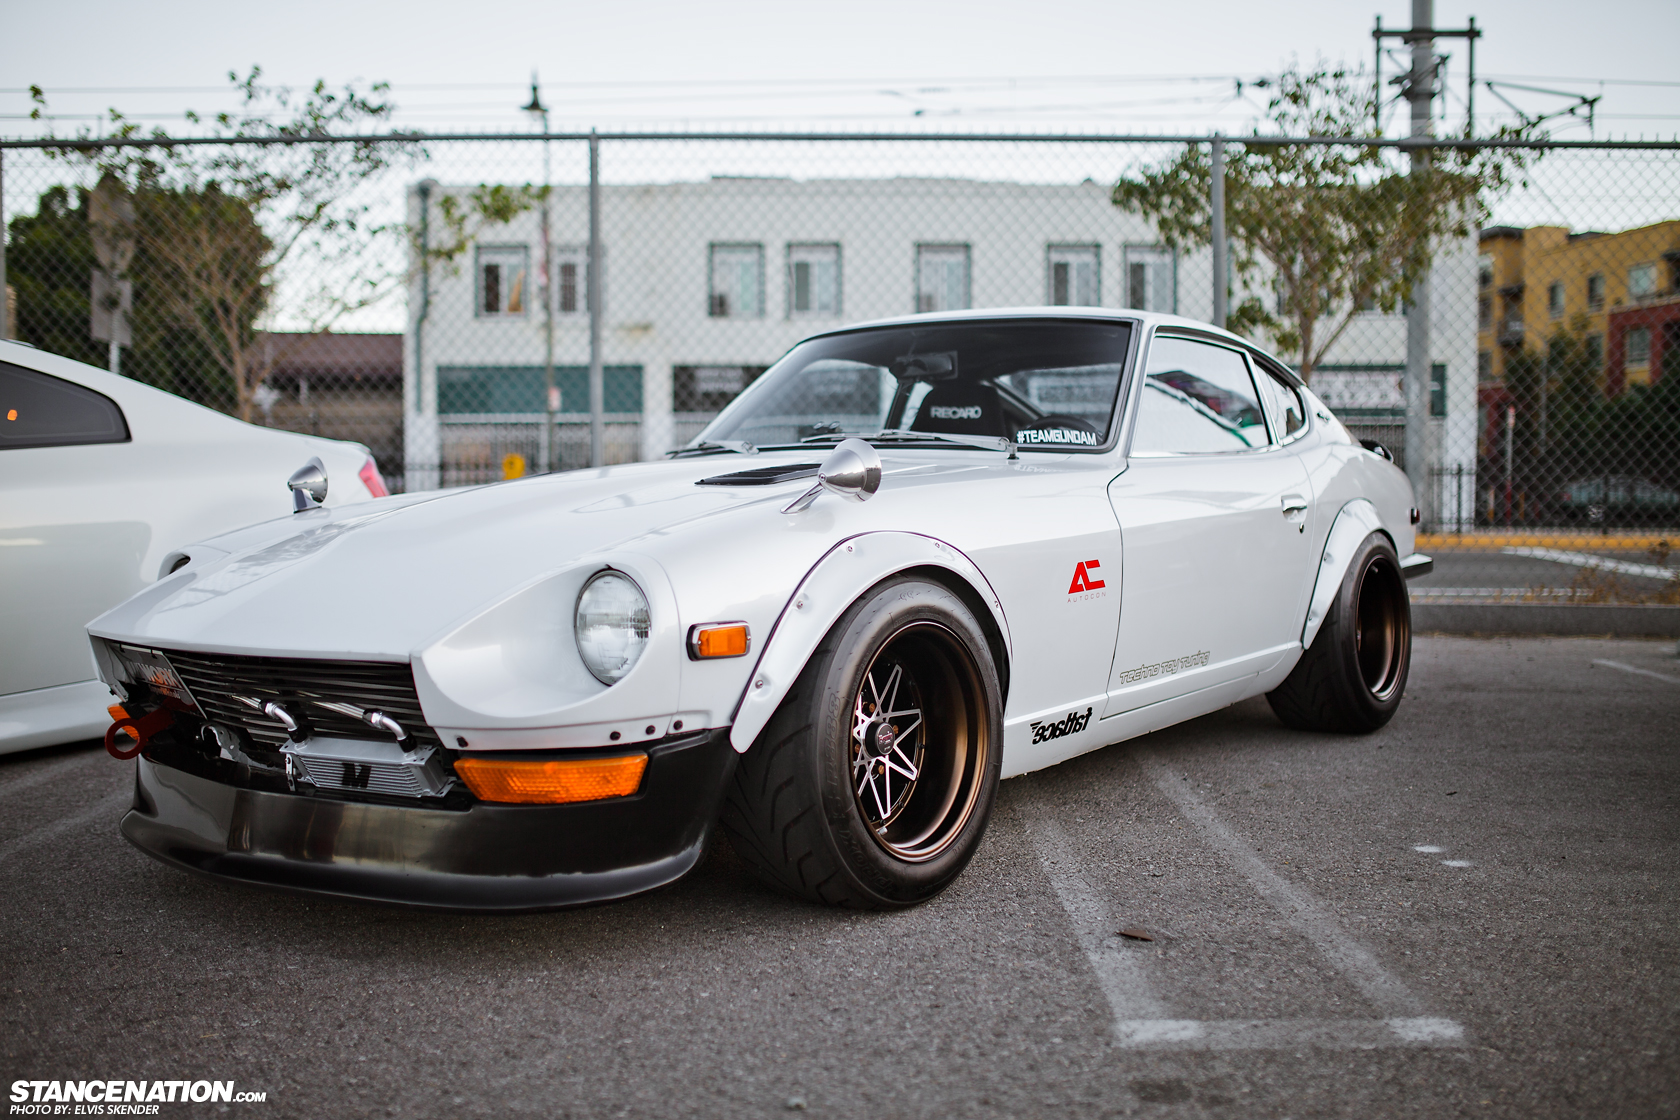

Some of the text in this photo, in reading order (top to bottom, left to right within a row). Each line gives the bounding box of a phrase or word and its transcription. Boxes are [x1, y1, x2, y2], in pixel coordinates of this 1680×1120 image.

[930, 405, 982, 420] RECARO
[1016, 428, 1097, 446] #TEAMGUNDAM
[1068, 559, 1106, 594] AC
[1067, 592, 1106, 603] AUTOCON
